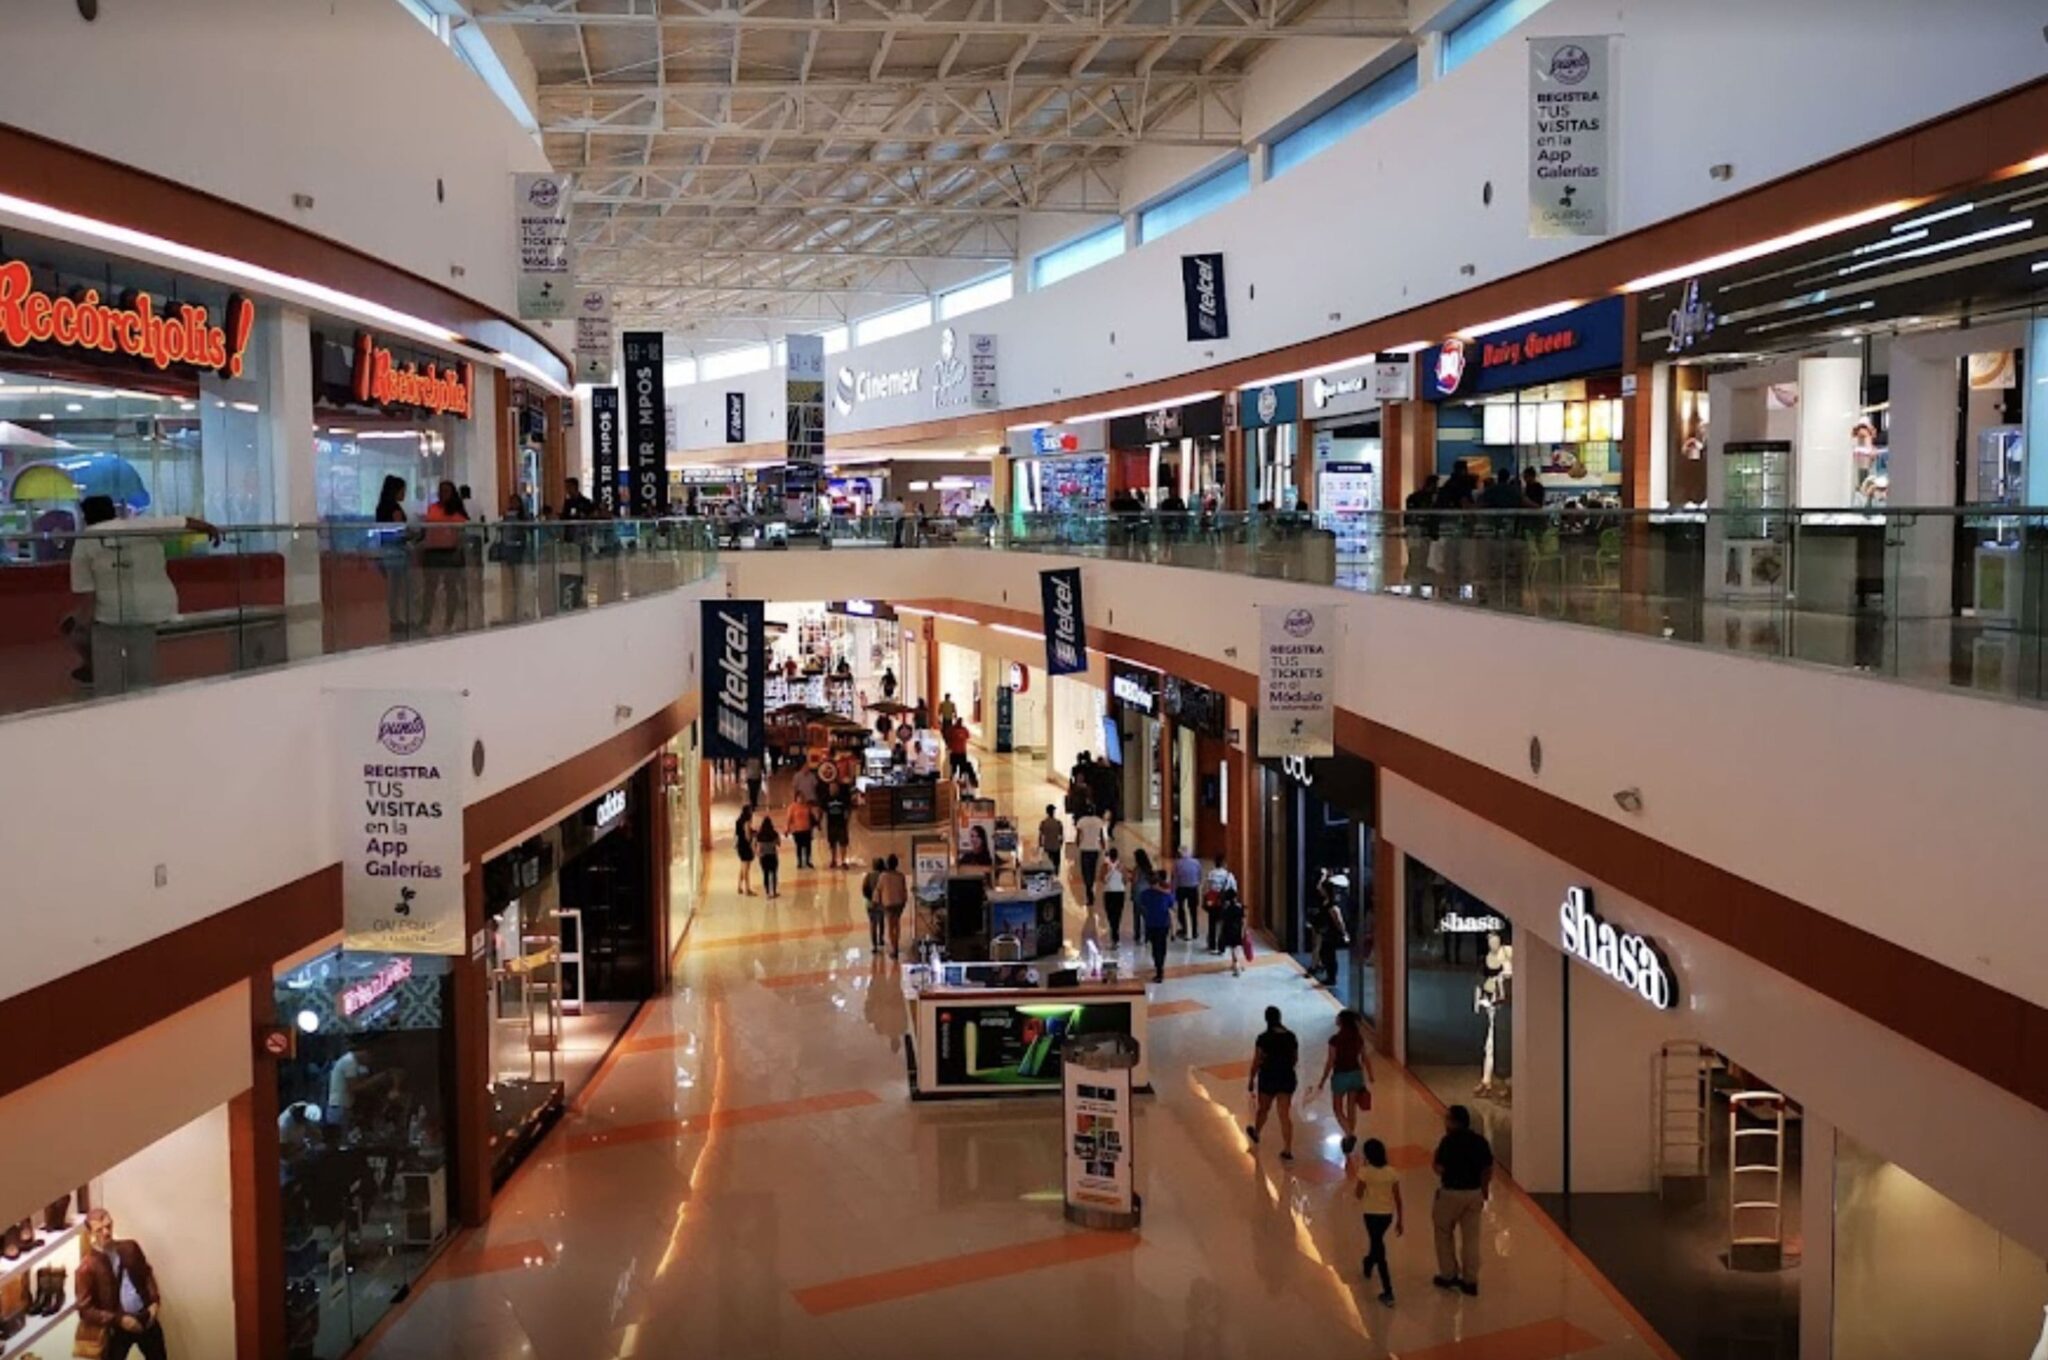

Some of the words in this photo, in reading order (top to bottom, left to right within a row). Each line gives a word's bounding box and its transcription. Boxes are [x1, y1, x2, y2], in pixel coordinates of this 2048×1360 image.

[1537, 91, 1600, 103] REGISTRA
[1538, 105, 1570, 118] TUS
[1538, 119, 1600, 132] VISITAS
[1537, 137, 1555, 147] en
[1559, 134, 1572, 146] la
[1537, 150, 1571, 163] App
[522, 227, 545, 236] TUS
[1483, 342, 1520, 368] Dairy
[1524, 331, 1573, 358] Queen
[857, 367, 921, 402] Cinemex
[1050, 576, 1075, 642] telcel
[1270, 644, 1324, 655] REGISTRA
[719, 610, 748, 713] telcel
[1271, 656, 1299, 667] TUS
[1271, 668, 1323, 678] TICKETS
[1269, 691, 1323, 703] Módulo
[364, 764, 441, 779] REGISTRA
[365, 781, 404, 798] TUS
[366, 800, 443, 818] VISITAS
[365, 821, 388, 834] en
[392, 819, 408, 835] la
[366, 838, 408, 857] App
[365, 861, 442, 878] Galerías
[1440, 912, 1505, 932] shasa
[1559, 886, 1671, 1011] shasa
